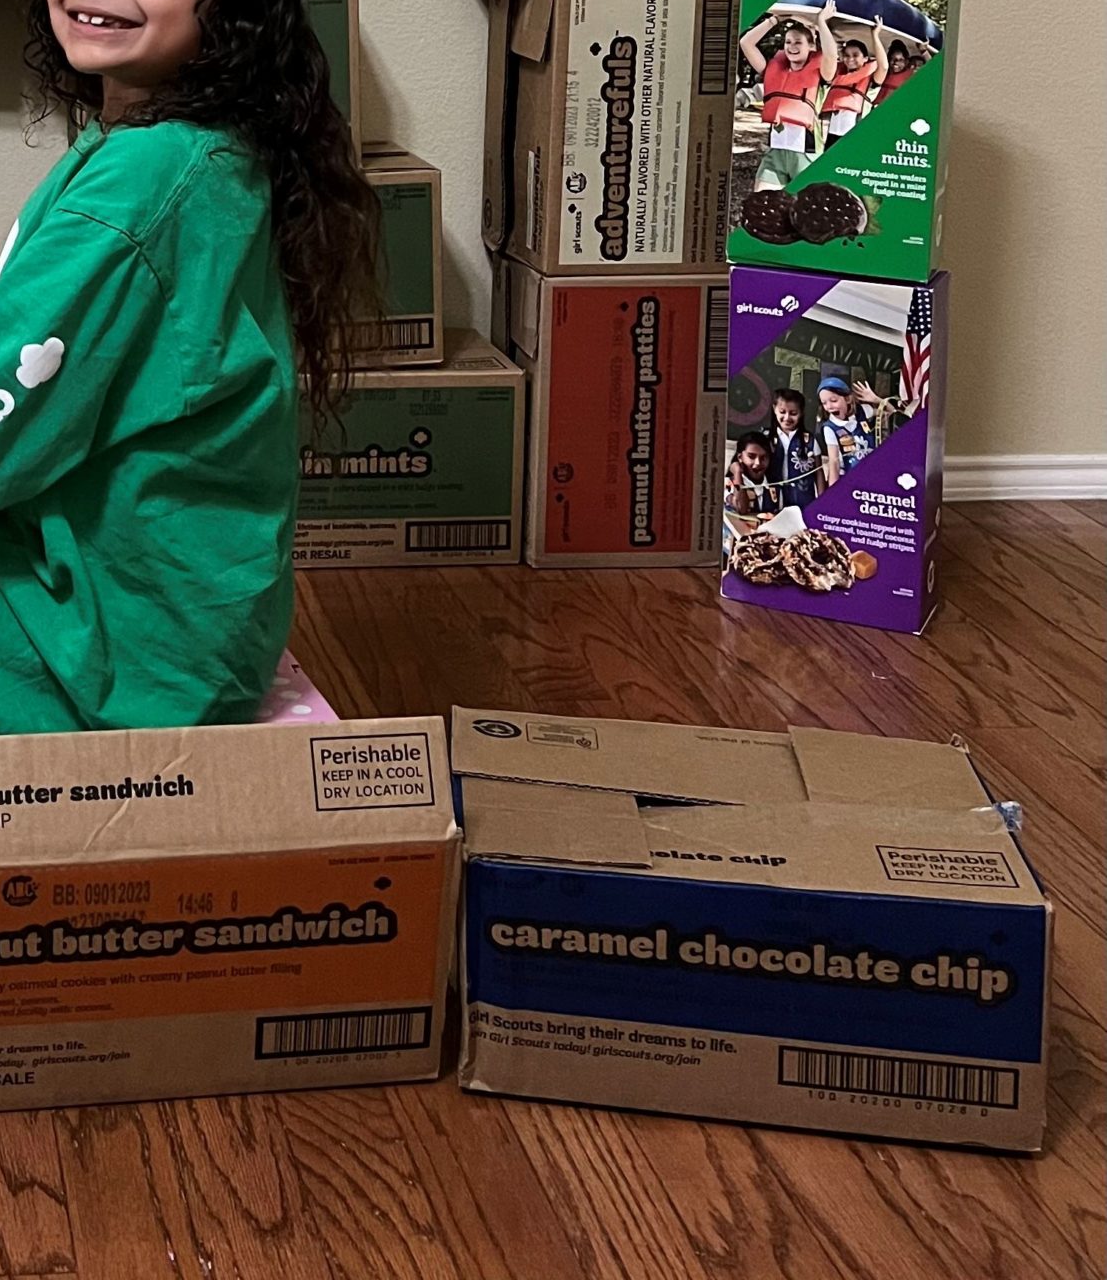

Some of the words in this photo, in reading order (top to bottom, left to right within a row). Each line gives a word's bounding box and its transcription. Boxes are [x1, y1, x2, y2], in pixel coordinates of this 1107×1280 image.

[643, 37, 655, 81] NATURAL
[641, 85, 652, 117] OTHER
[640, 120, 651, 145] WITH
[895, 139, 929, 154] thin
[600, 41, 632, 257] adventurefuls
[638, 147, 649, 196] FLAVORED
[635, 199, 646, 253] NATURALLY
[736, 302, 753, 315] girl
[753, 304, 784, 317] scouts
[635, 300, 657, 383] patties
[631, 387, 652, 460] butter
[340, 448, 428, 475] mints
[633, 463, 652, 543] peanut
[852, 489, 916, 509] caramel
[320, 743, 422, 765] Perishable
[69, 774, 195, 802] sandwich
[322, 769, 354, 782] KEEP
[357, 769, 371, 780] IN
[374, 768, 384, 779] A
[386, 766, 423, 779] COOL
[324, 786, 351, 799] DRY
[355, 783, 425, 797] LOCATION
[730, 854, 787, 867] chip
[888, 851, 1000, 867] Perishable
[893, 869, 926, 878] DRY
[929, 871, 1008, 883] LOCATION
[52, 927, 184, 956] butter
[193, 908, 389, 948] sandwich
[490, 922, 669, 962] caramel
[678, 936, 900, 983] chocolate
[910, 955, 1010, 1001] chip
[492, 1015, 544, 1033] Scouts
[547, 1022, 586, 1040] bring
[589, 1025, 625, 1042] their
[628, 1029, 687, 1048] dreams
[691, 1035, 707, 1050] to
[709, 1037, 738, 1054] life.
